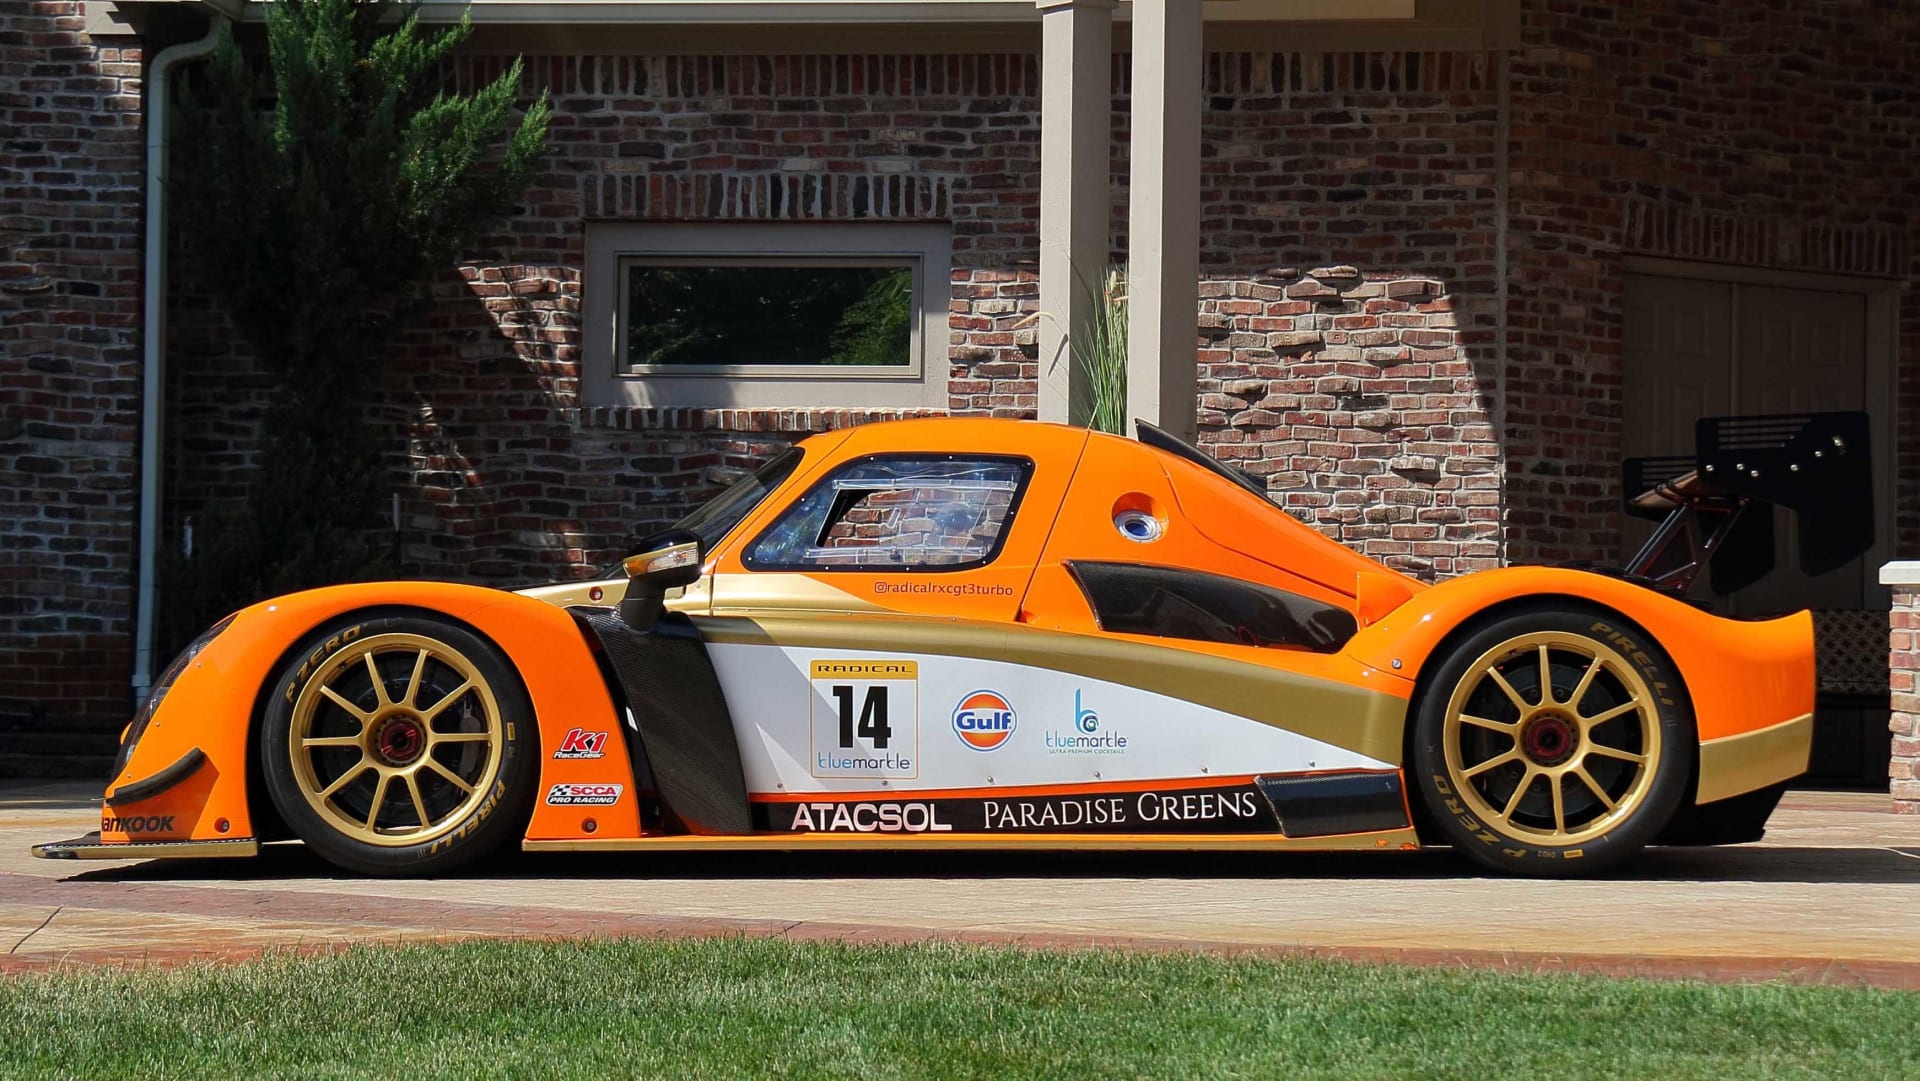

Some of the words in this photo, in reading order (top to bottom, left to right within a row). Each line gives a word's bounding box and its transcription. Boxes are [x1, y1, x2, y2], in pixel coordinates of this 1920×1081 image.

[817, 665, 913, 673] RADICAL
[1590, 622, 1675, 706] PIRELLI
[832, 685, 892, 749] 14
[956, 711, 1012, 730] Gulf
[560, 728, 608, 753] K1
[570, 786, 616, 795] SCCA
[430, 779, 506, 855] PIRELLI
[791, 803, 952, 832] ATACSOL
[983, 798, 1127, 829] PARADISE
[1136, 792, 1257, 821] GREENS
